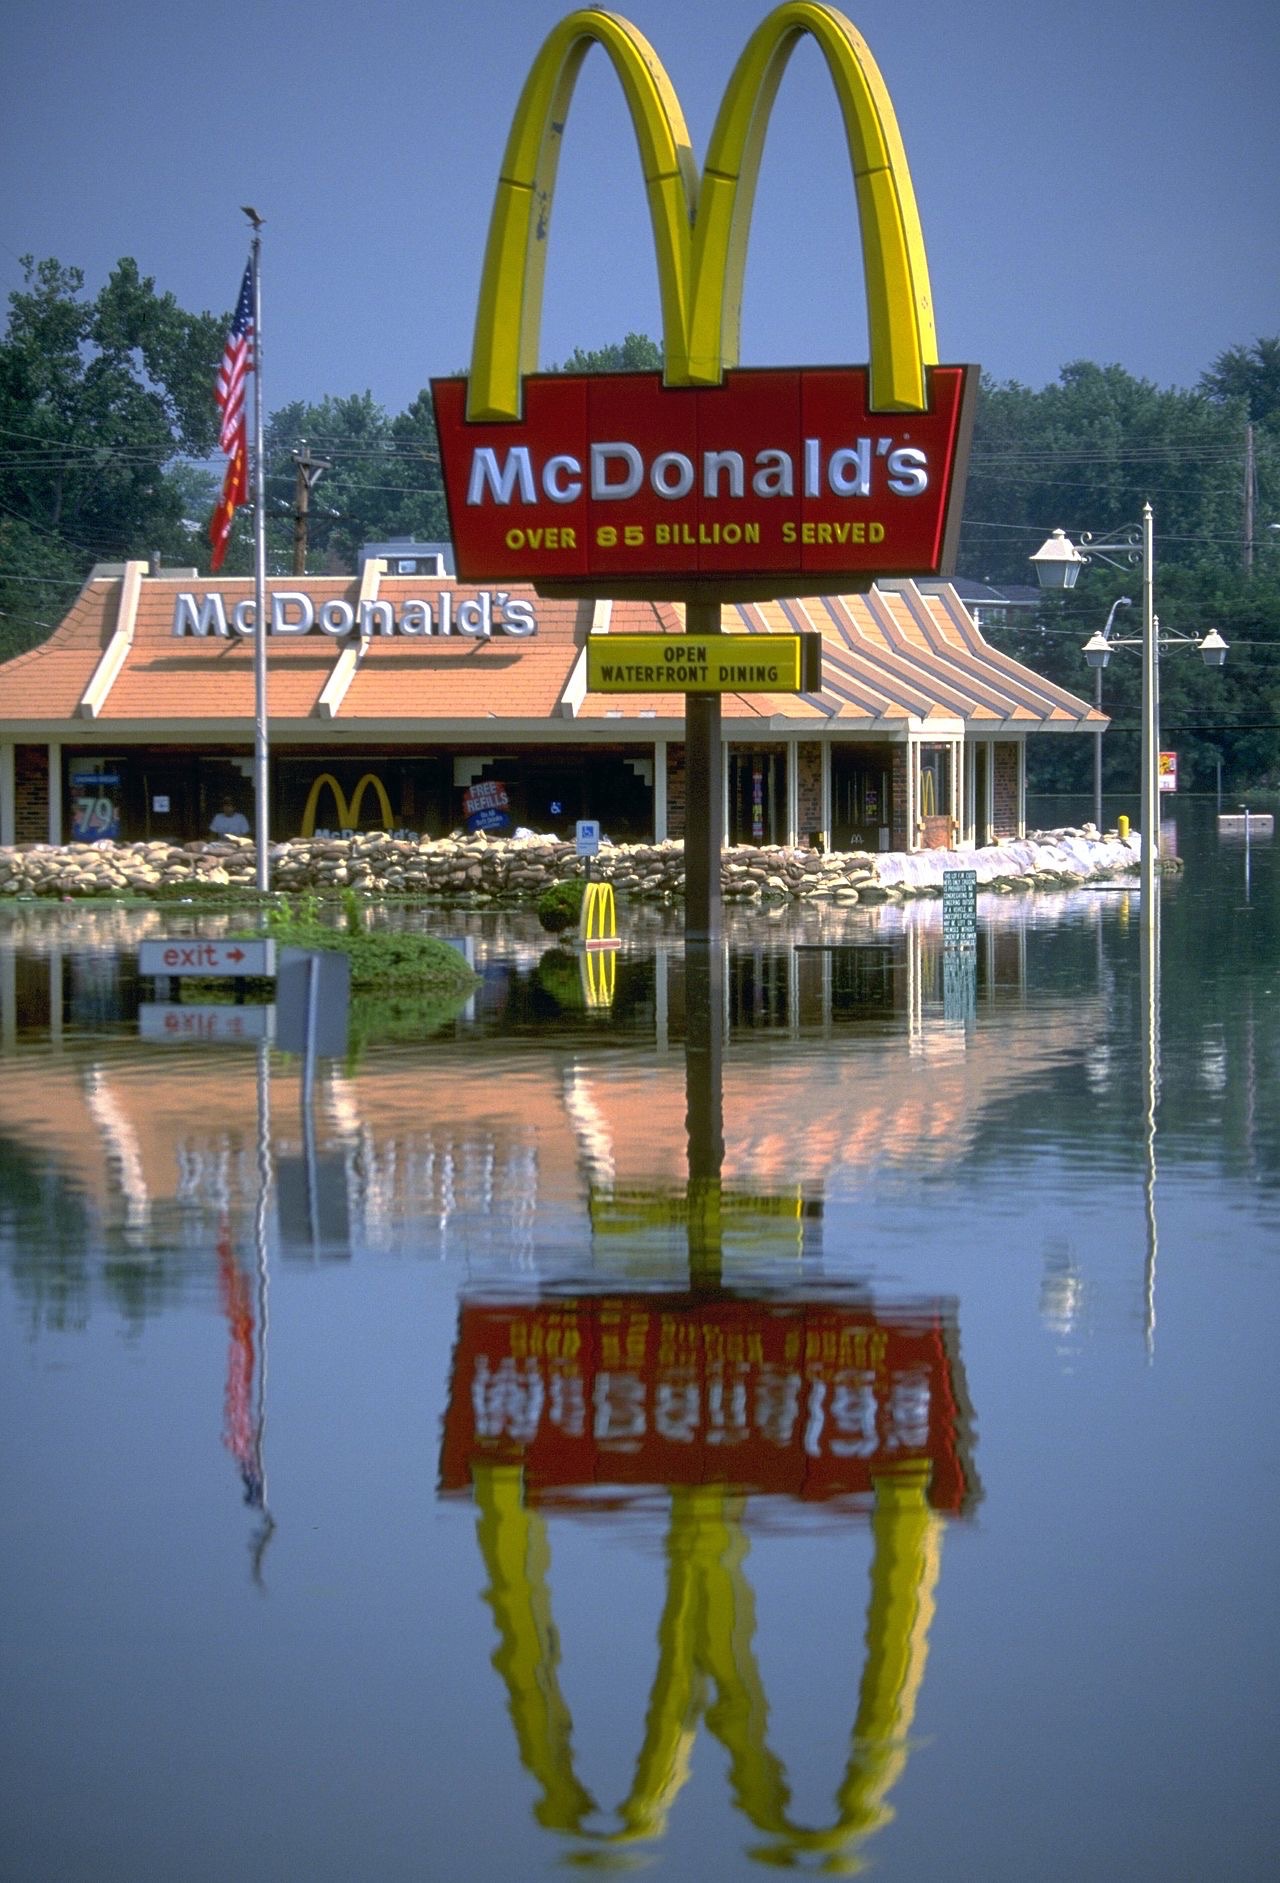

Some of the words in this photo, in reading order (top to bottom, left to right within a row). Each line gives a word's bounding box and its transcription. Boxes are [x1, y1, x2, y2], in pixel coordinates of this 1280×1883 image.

[466, 437, 930, 507] McDonald's
[505, 527, 577, 551] OVER
[595, 526, 645, 548] 85
[655, 522, 760, 545] BILLION
[782, 521, 886, 545] SERVED
[172, 591, 537, 638] McDonald's
[664, 646, 708, 663] OPEN
[601, 665, 709, 683] WATERFRONT
[719, 665, 778, 683] DINING
[469, 780, 497, 798] FREE
[466, 791, 509, 813] REFILLS
[76, 797, 113, 834] 79
[163, 943, 219, 968] exit
